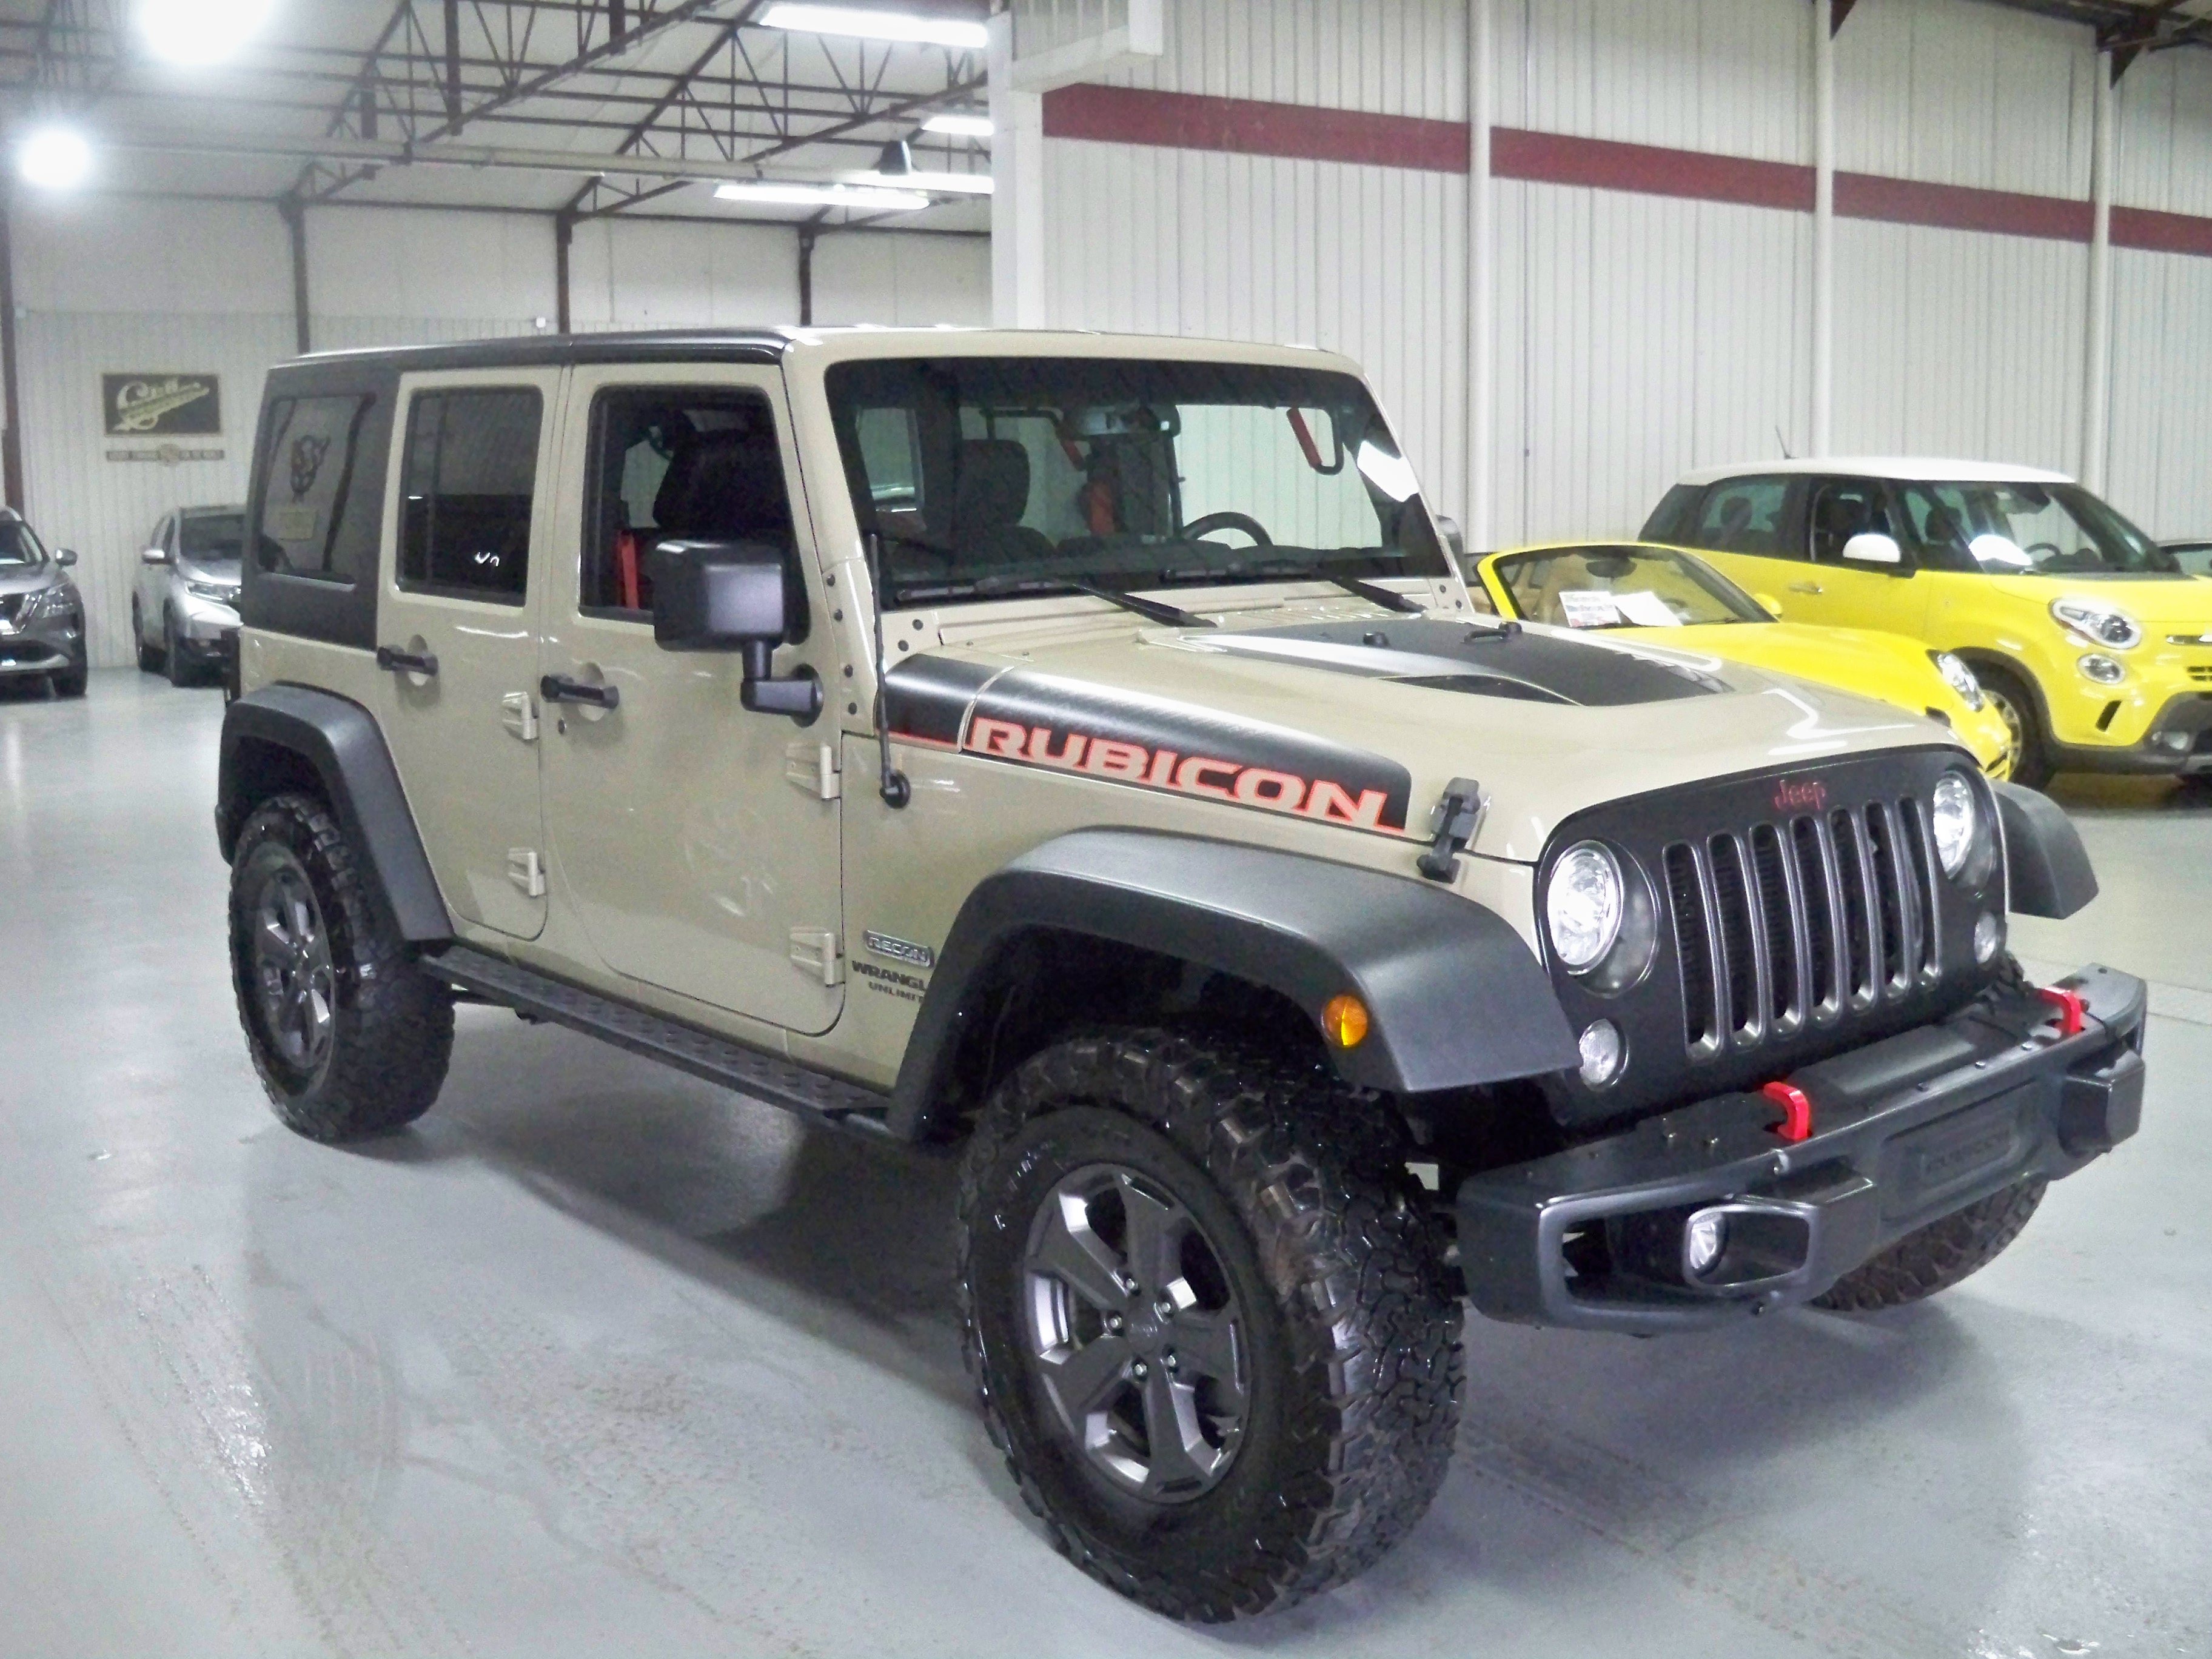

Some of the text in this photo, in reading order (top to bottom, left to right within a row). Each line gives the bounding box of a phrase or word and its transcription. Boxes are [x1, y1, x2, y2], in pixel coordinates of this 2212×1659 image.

[972, 716, 1389, 829] RUBICON
[1774, 779, 1826, 810] Jeep
[852, 960, 926, 991] WRANGL
[868, 981, 924, 1003] UNLIMIT
